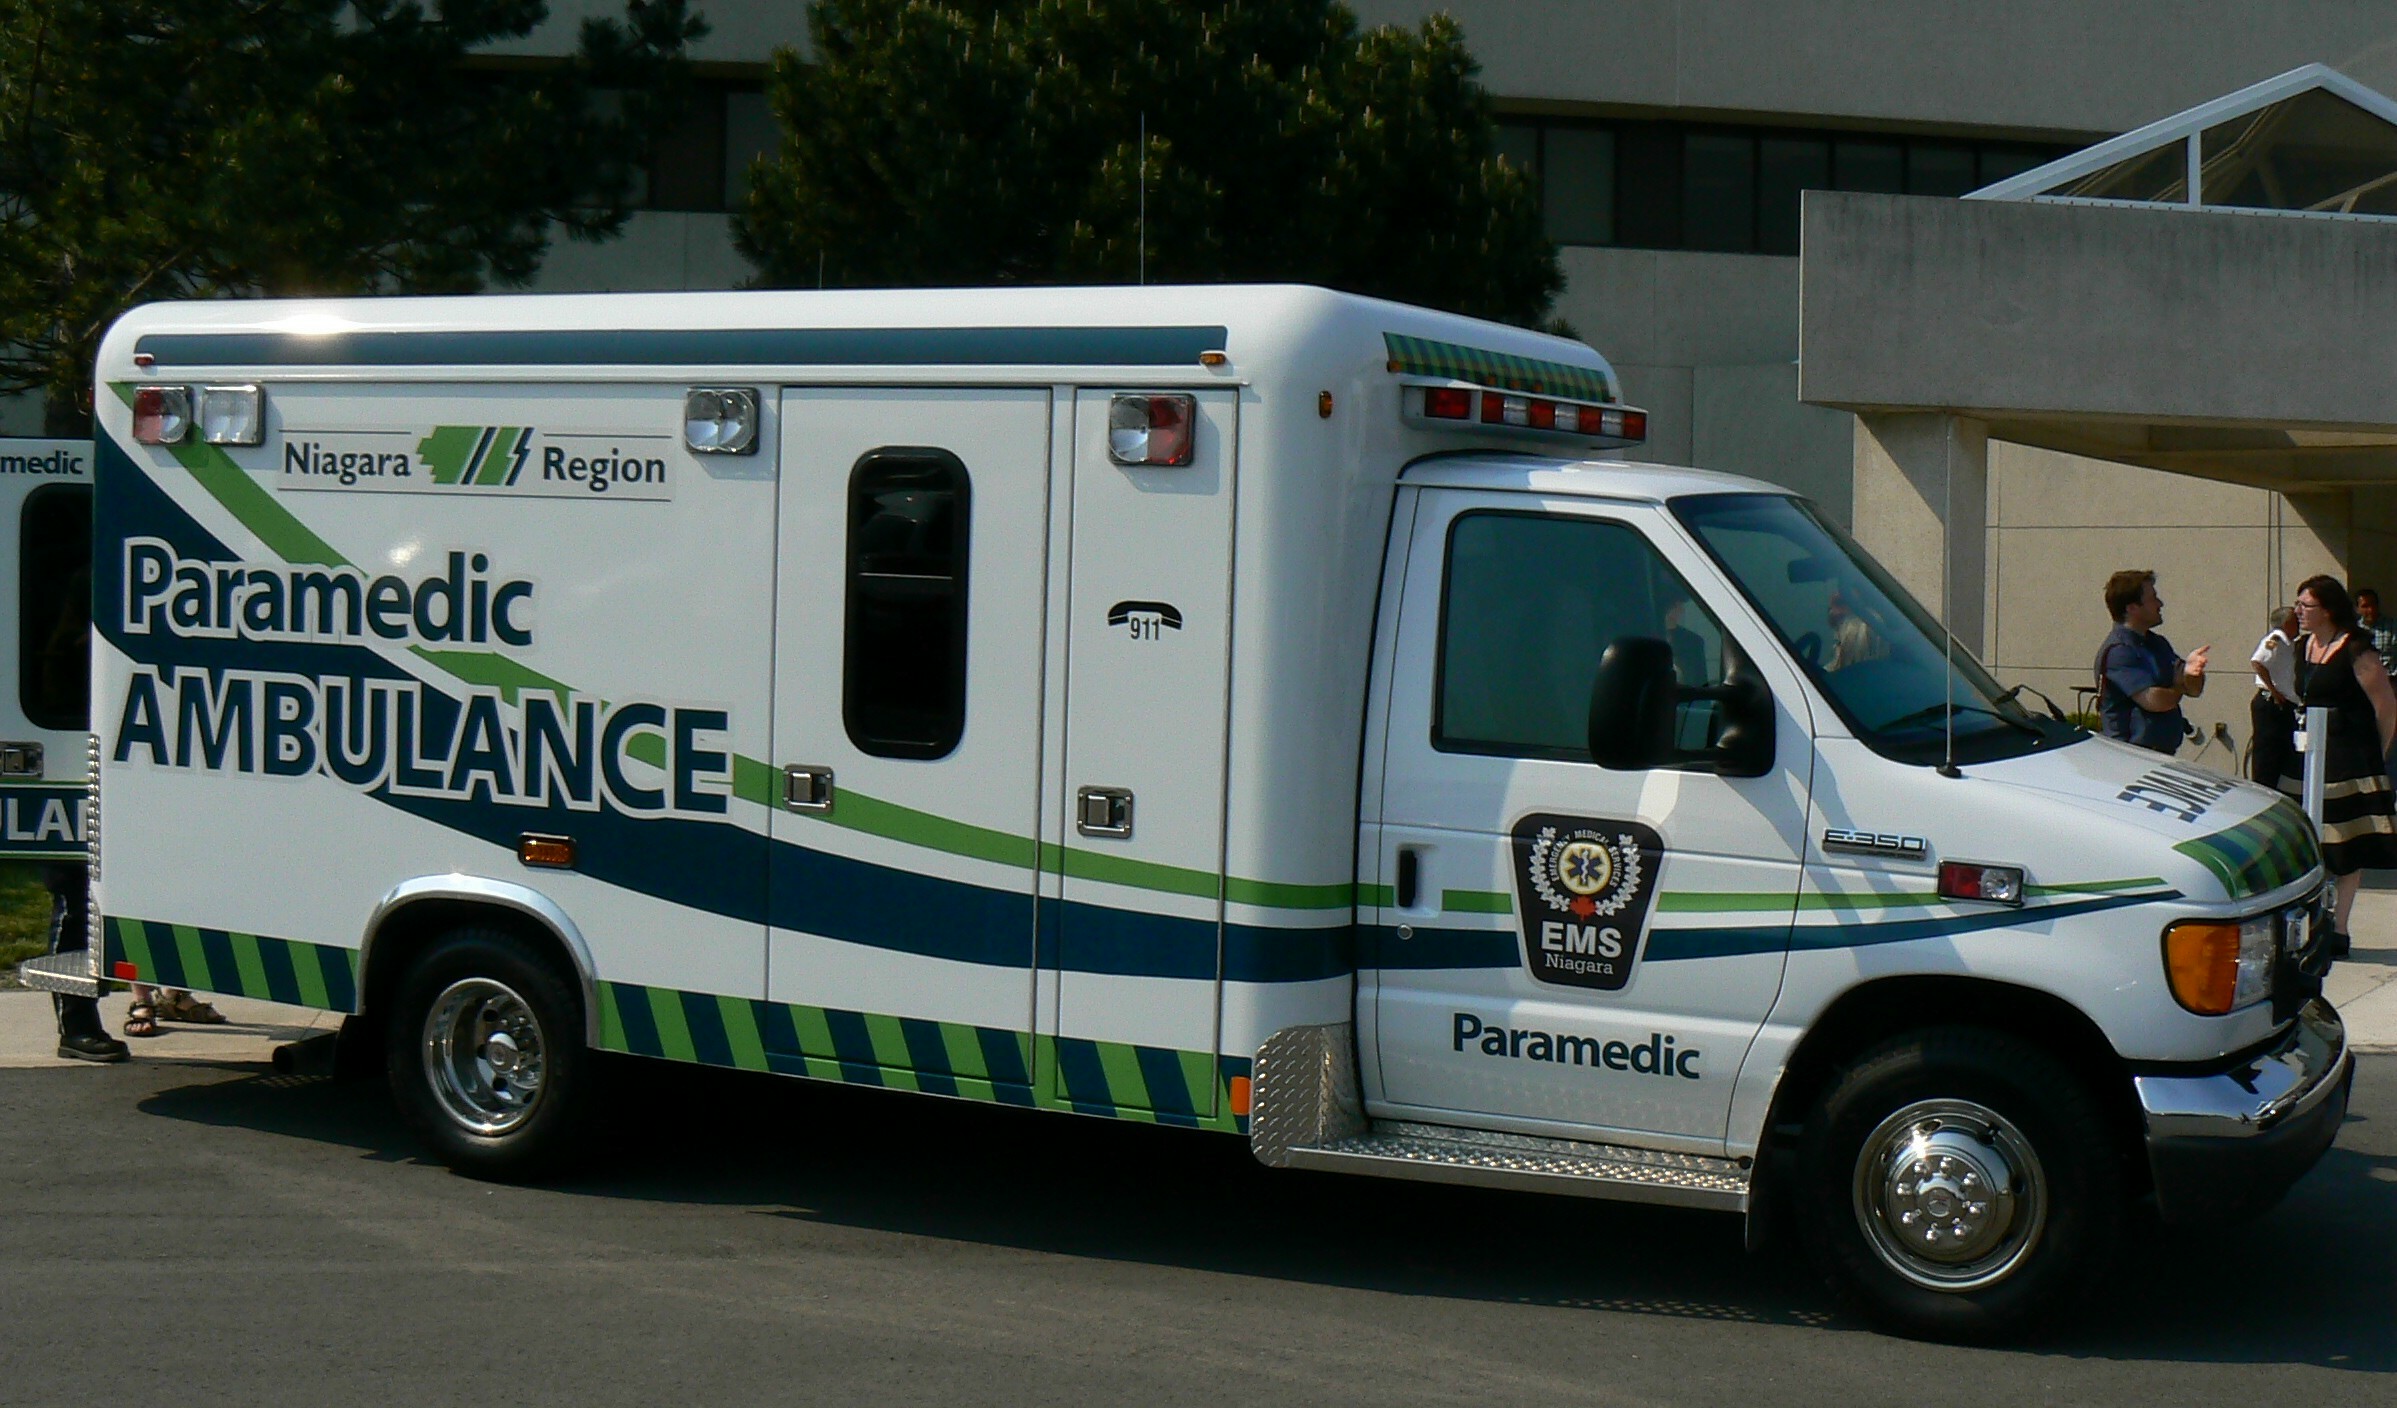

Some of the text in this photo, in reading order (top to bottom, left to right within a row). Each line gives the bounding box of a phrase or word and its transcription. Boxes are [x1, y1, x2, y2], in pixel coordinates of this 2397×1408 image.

[284, 442, 666, 492] Niagara Region
[129, 543, 534, 647] Paramedic
[1130, 617, 1160, 641] 911
[114, 672, 729, 814] AMBULANCE
[0, 798, 89, 842] LA
[1574, 829, 1610, 845] MEDICAL
[1608, 845, 1622, 888] SERVICES
[1541, 920, 1622, 959] EMS
[1545, 953, 1614, 975] Niagara
[1453, 1012, 1700, 1080] Paramedic
